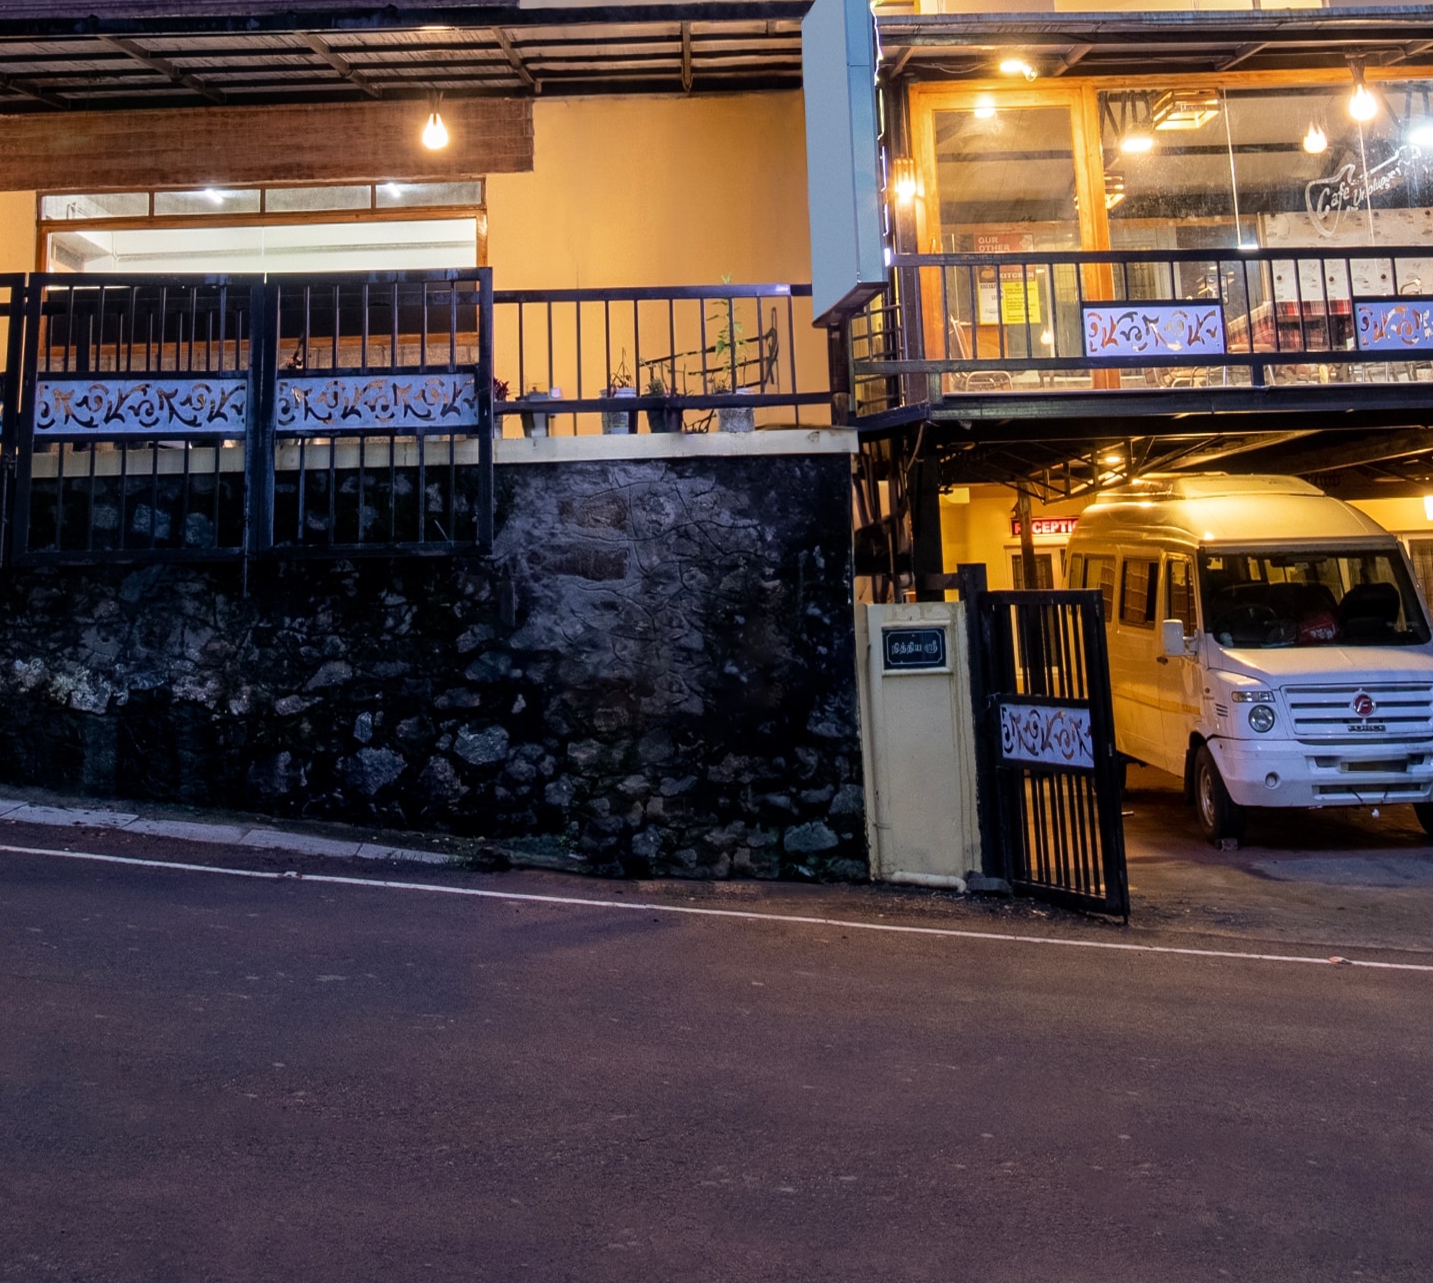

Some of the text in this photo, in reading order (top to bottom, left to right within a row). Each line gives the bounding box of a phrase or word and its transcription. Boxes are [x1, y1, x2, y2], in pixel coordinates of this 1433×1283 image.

[1317, 181, 1350, 219] Cafe
[978, 236, 998, 244] OUR
[1014, 520, 1079, 534] RCEPTI
